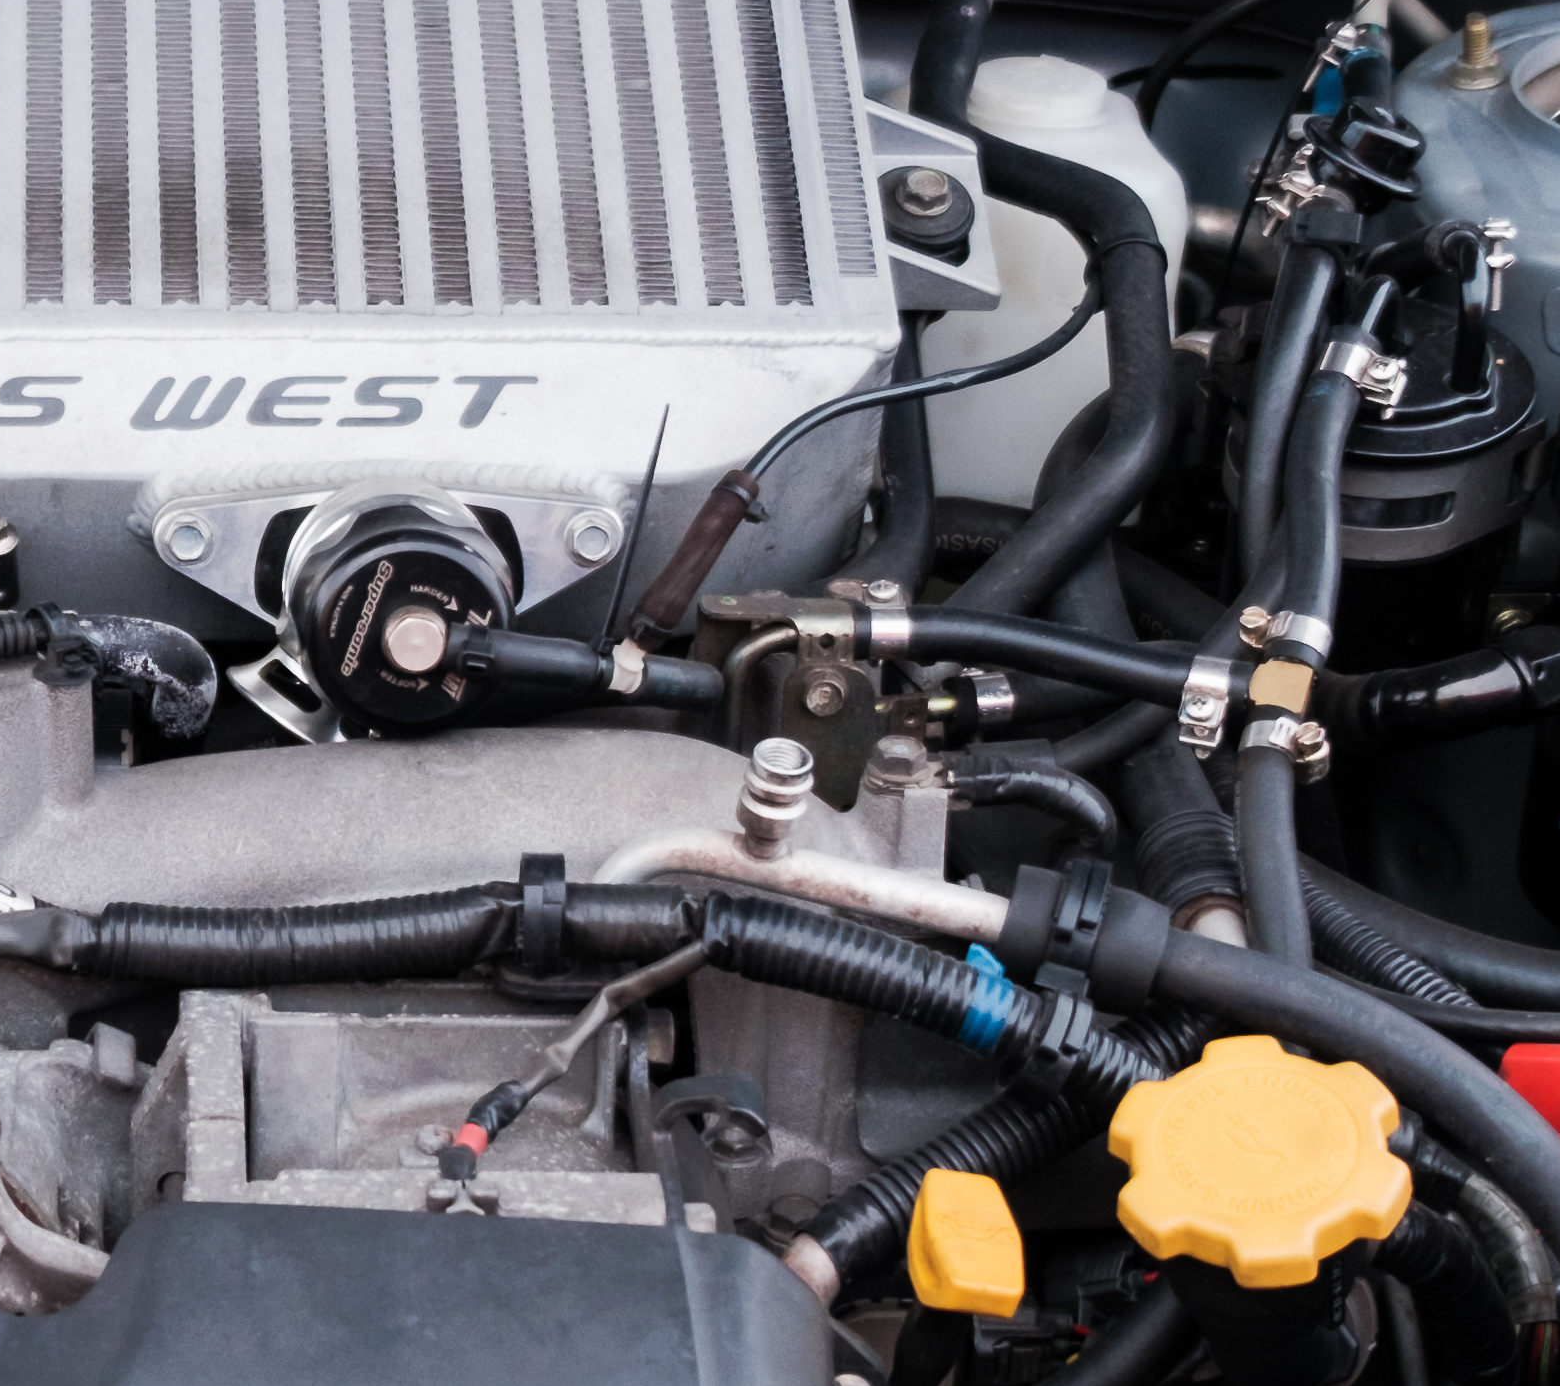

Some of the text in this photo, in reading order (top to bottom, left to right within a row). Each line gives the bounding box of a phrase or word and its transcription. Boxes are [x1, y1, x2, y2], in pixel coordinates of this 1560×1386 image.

[130, 374, 539, 432] WEST
[340, 560, 393, 676] Supersonic
[1244, 1073, 1340, 1120] ENGINE
[1227, 1174, 1338, 1215] MANUAL
